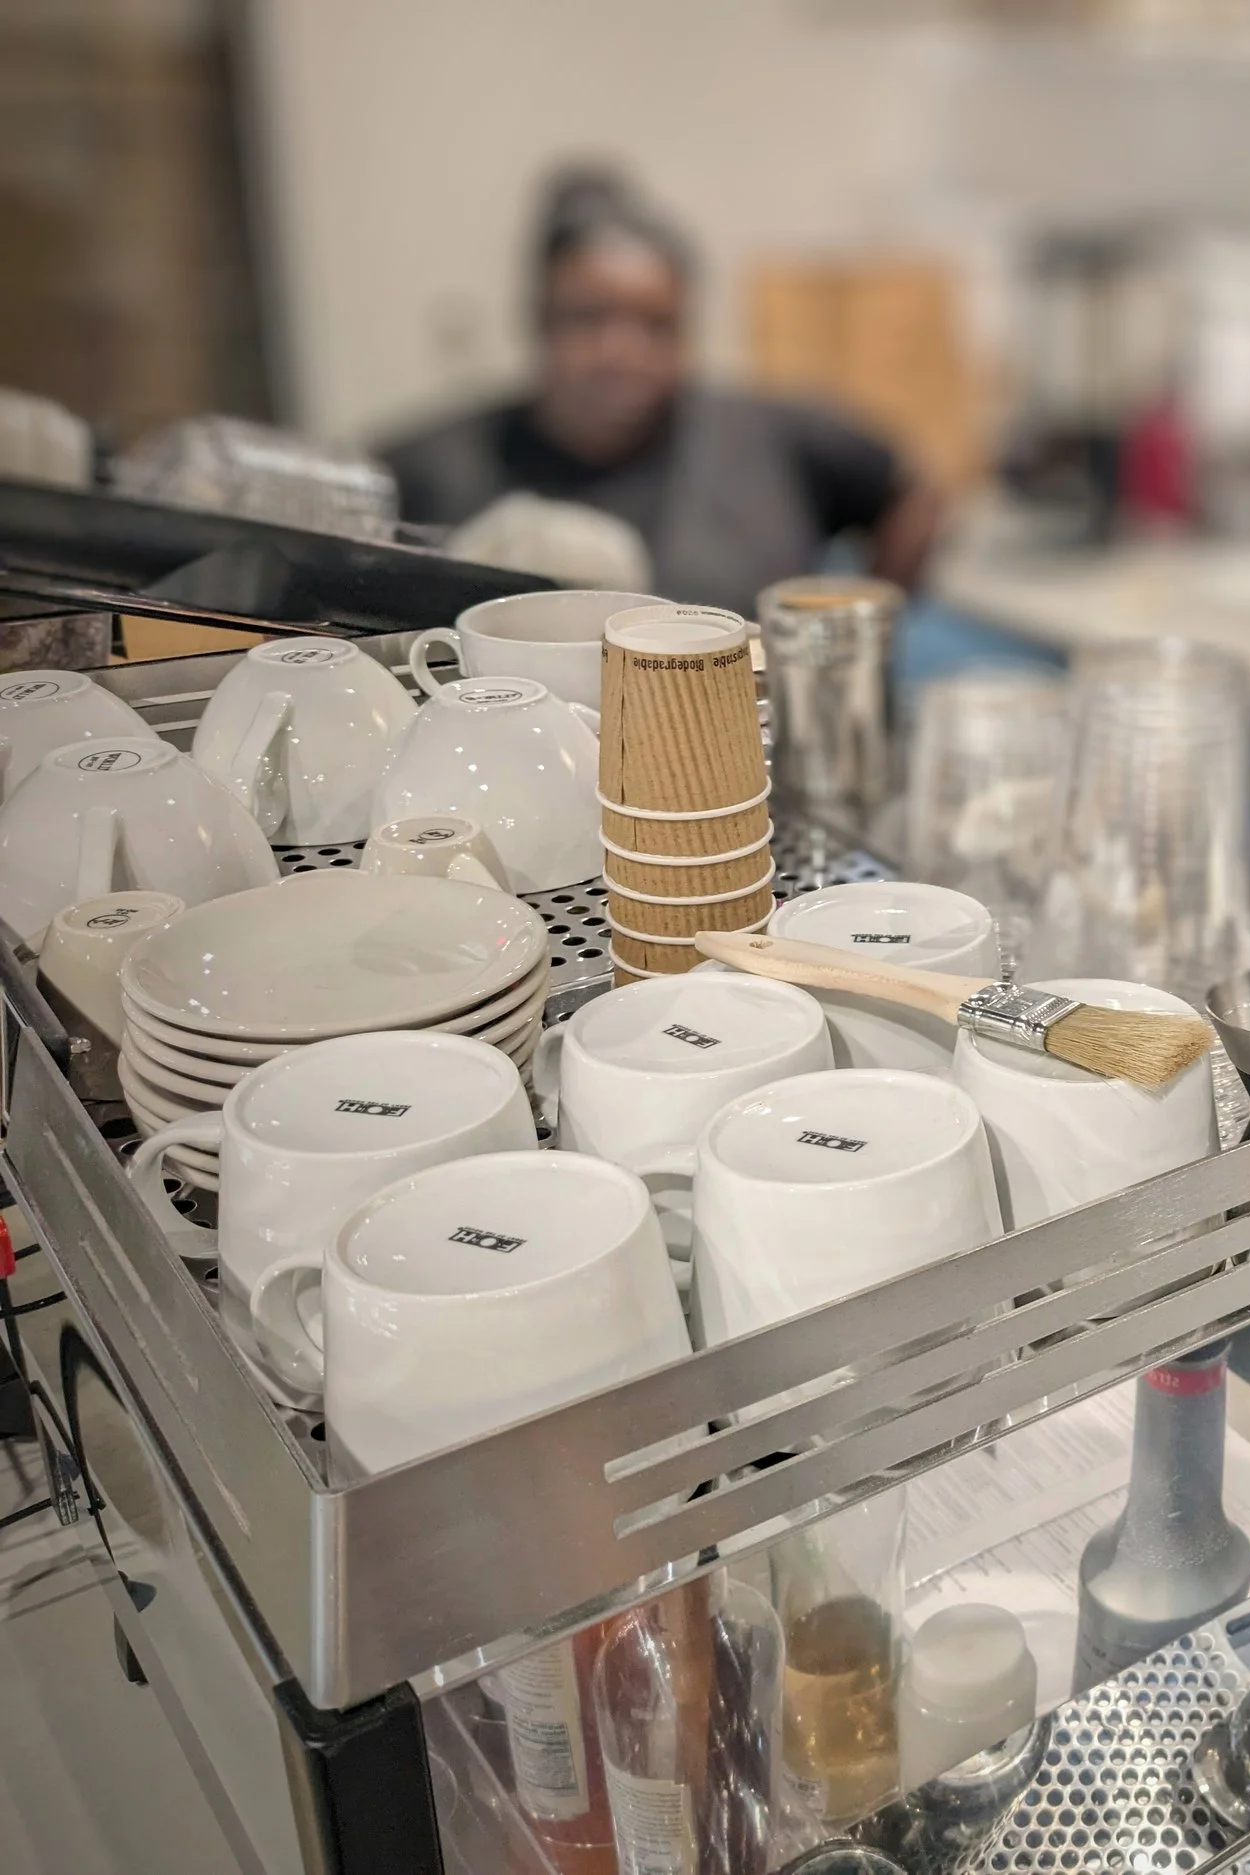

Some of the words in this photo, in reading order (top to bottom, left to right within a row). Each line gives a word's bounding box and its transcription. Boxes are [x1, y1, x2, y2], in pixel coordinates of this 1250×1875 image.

[633, 657, 704, 672] Biodegradable
[713, 647, 748, 668] postable
[337, 1102, 407, 1117] FOH
[799, 1133, 863, 1151] FOH
[450, 1230, 520, 1252] FOH
